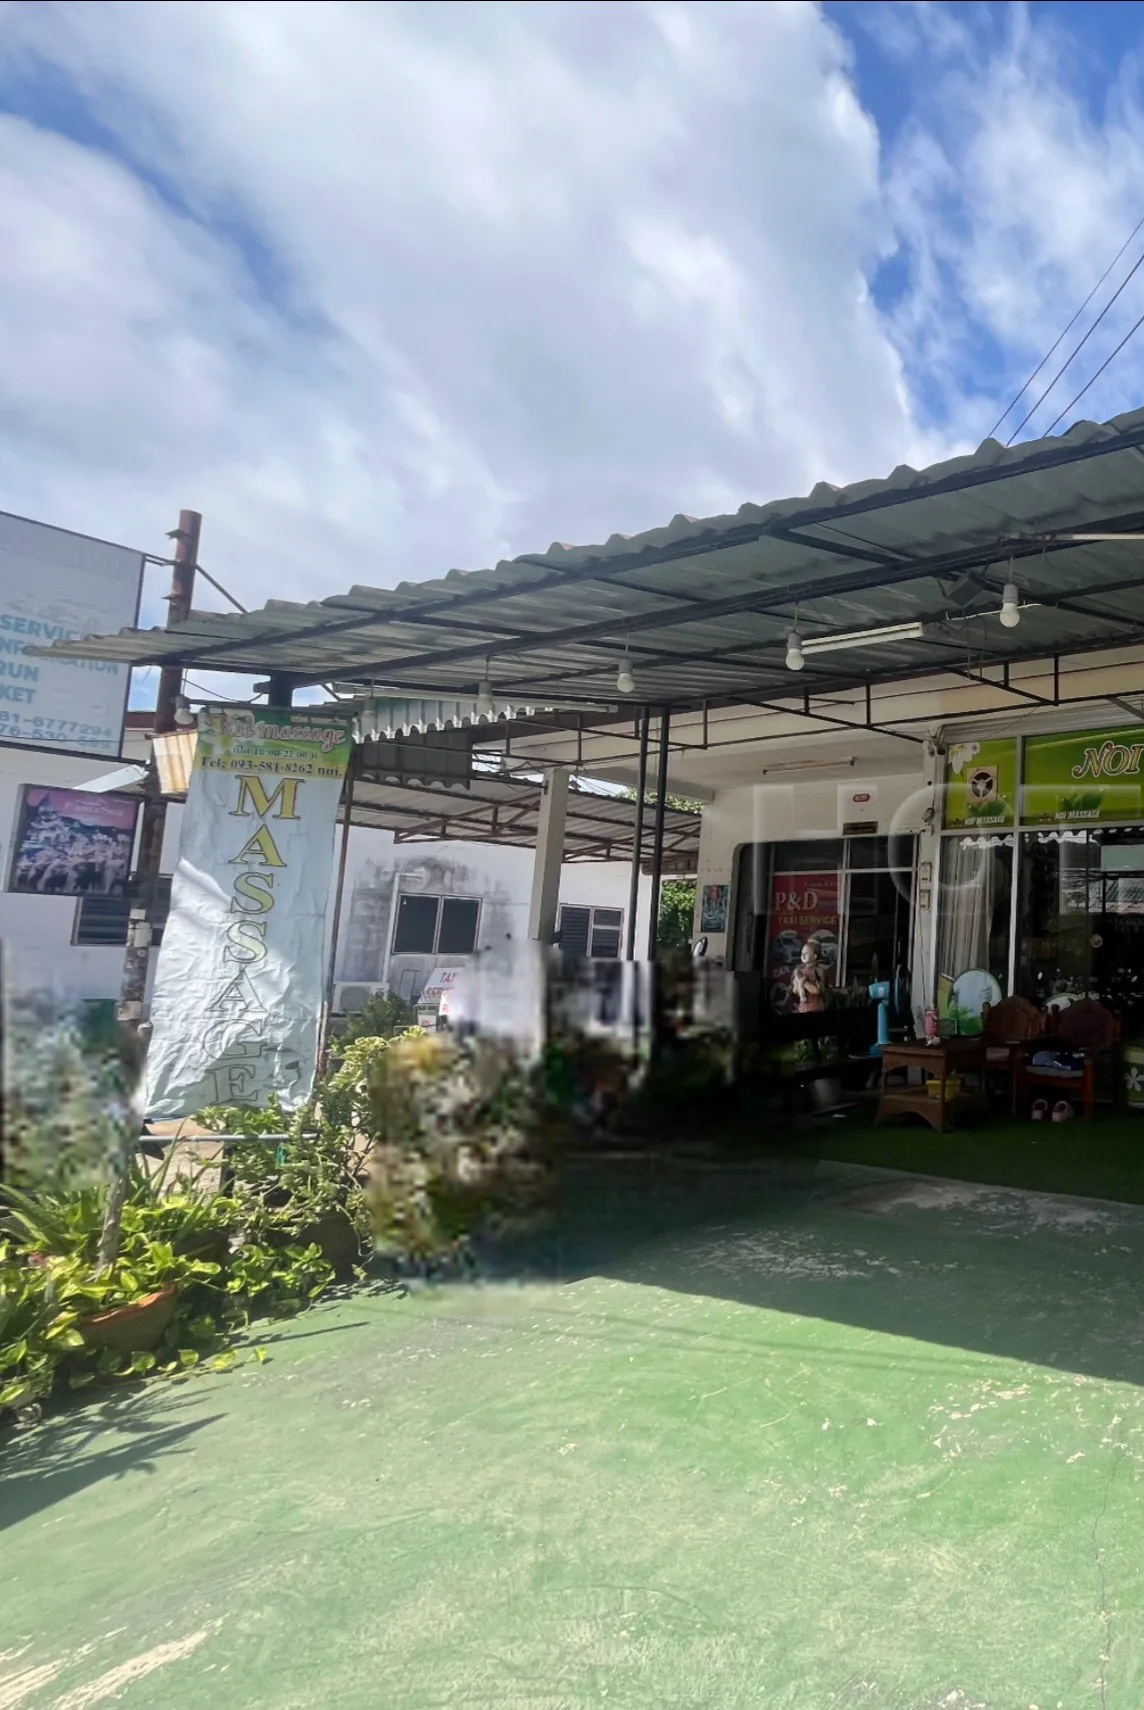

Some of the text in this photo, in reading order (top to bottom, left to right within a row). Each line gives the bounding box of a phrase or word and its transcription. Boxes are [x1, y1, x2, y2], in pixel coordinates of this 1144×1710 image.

[0, 613, 82, 641] SERVIC
[257, 723, 346, 753] massage
[230, 759, 313, 775] 093-581-8262
[1069, 809, 1101, 819] MASSAGE
[774, 892, 818, 911] P&D
[203, 774, 305, 1104] MASSAGE
